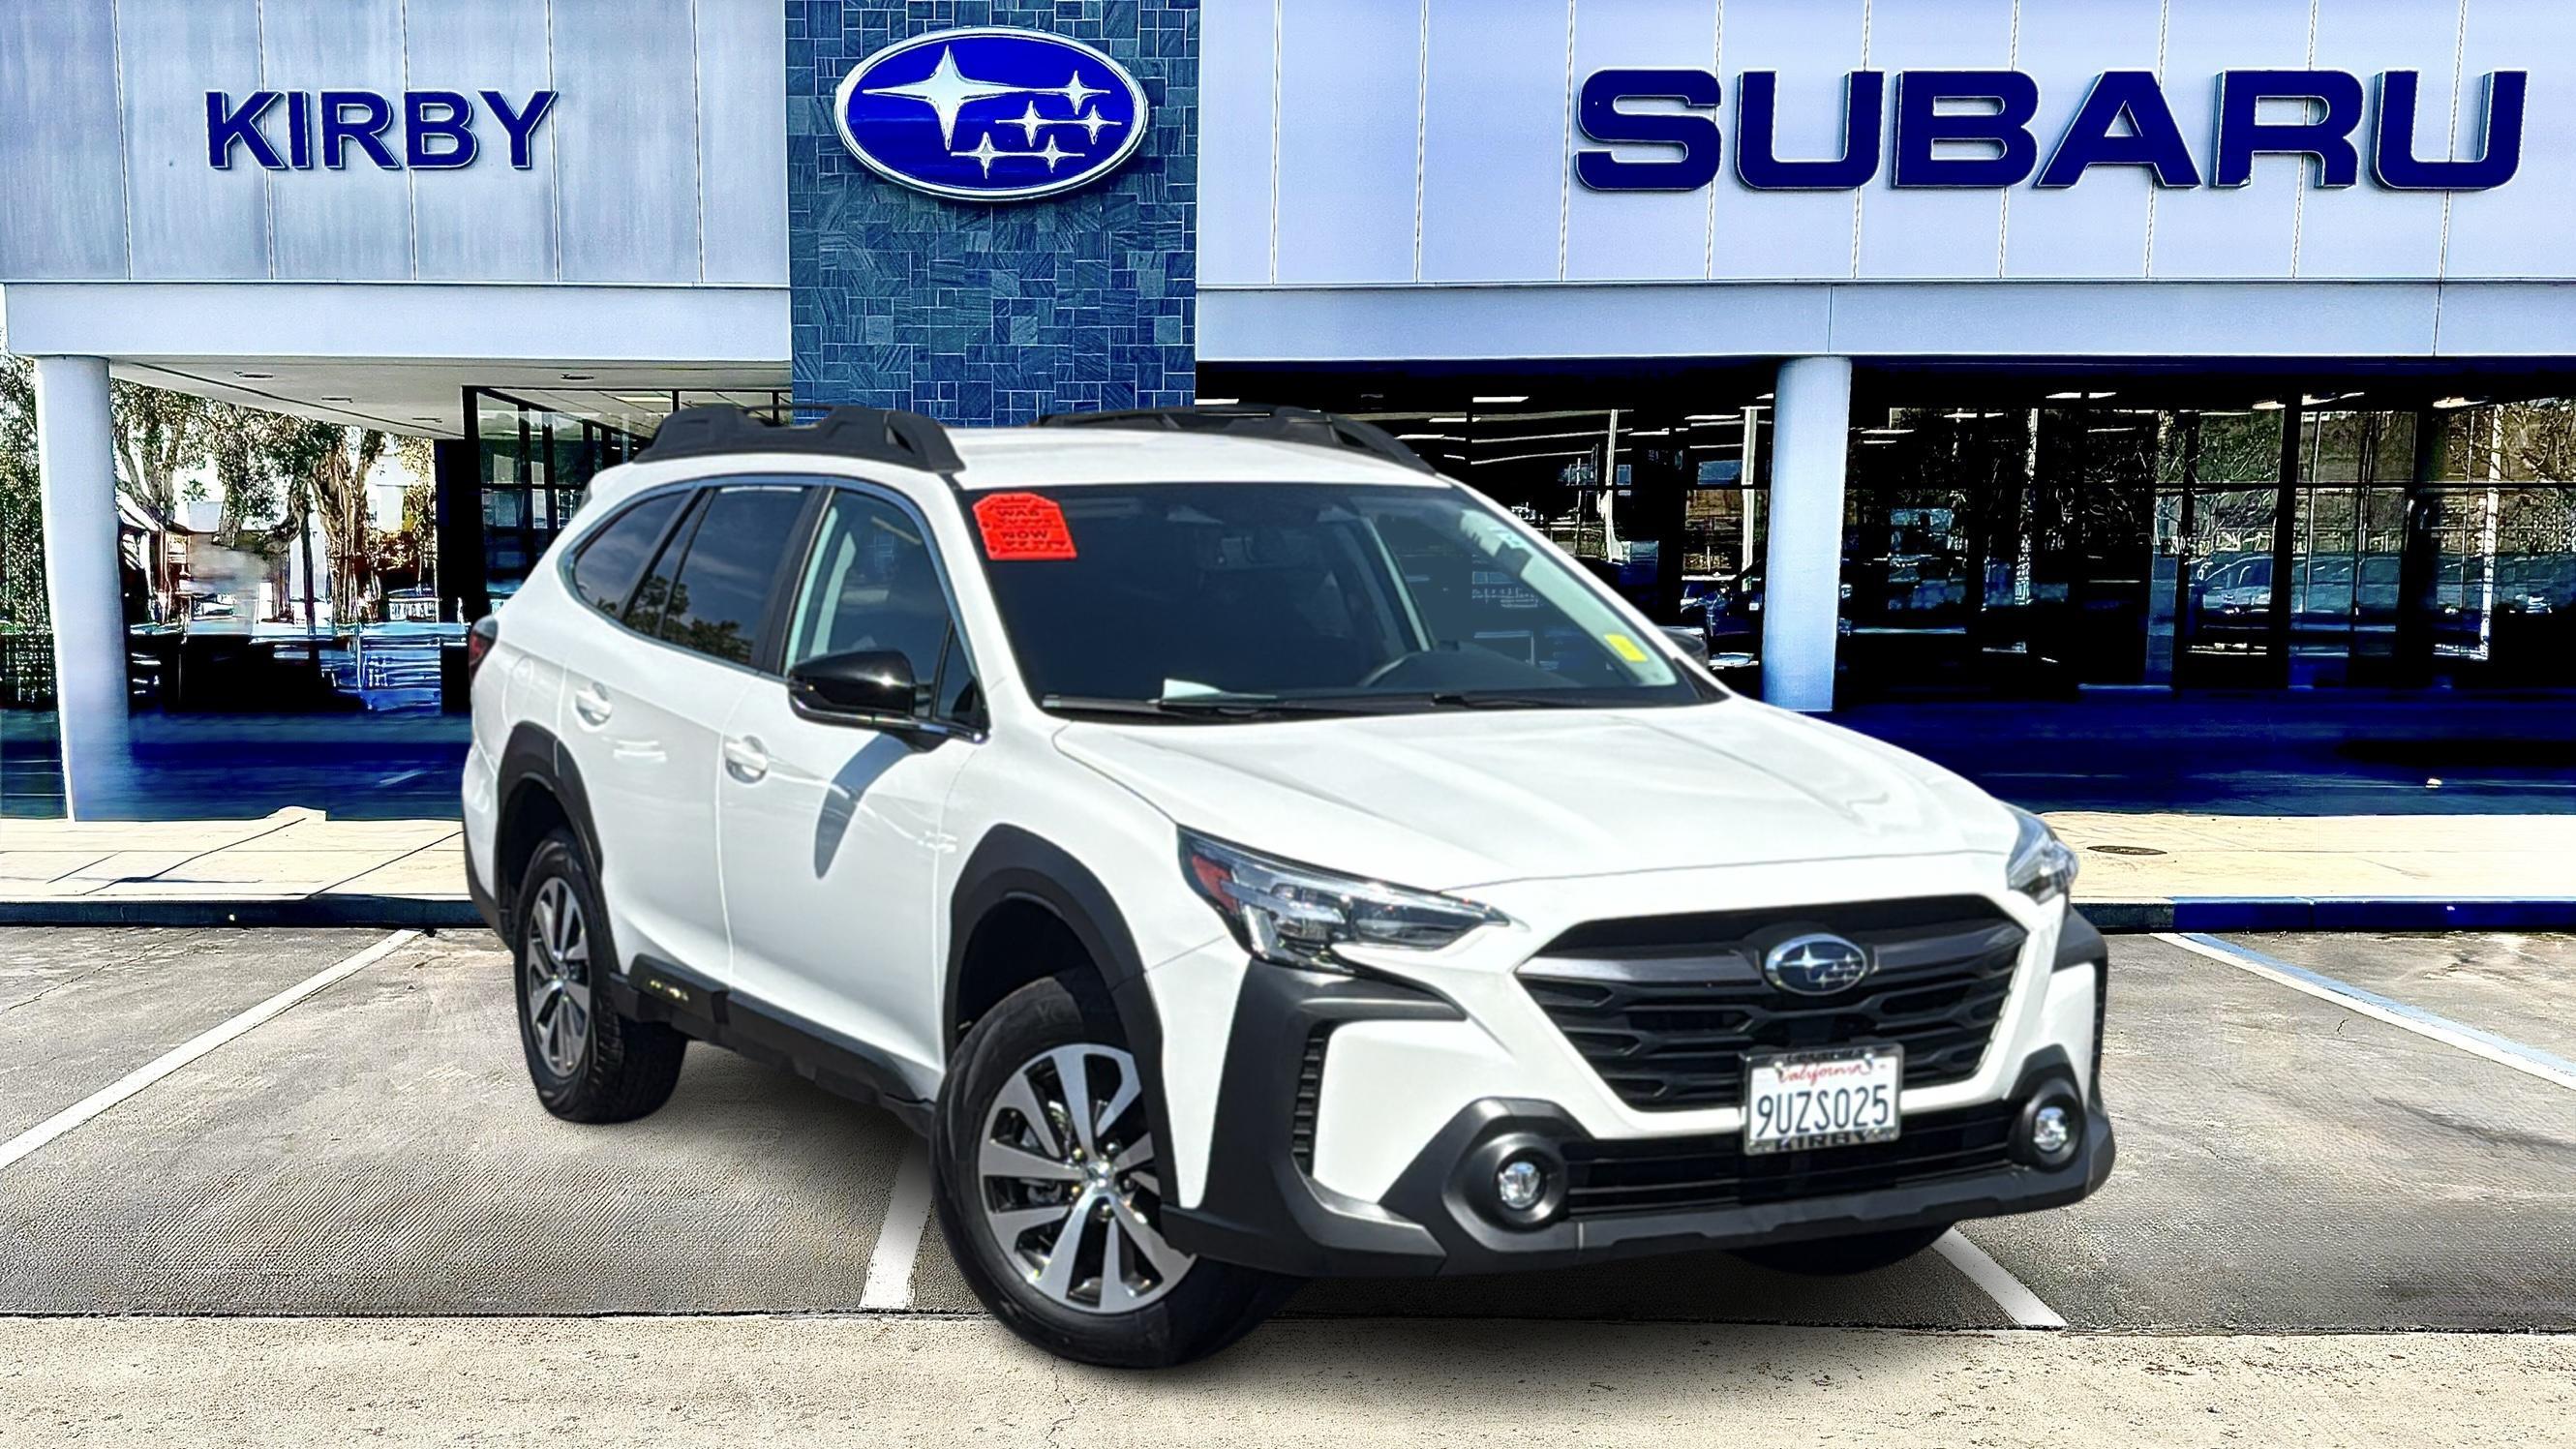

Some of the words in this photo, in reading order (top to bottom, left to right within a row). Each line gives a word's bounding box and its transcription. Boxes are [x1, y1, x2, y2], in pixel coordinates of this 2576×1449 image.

[205, 90, 559, 170] KIRBY
[1575, 69, 2528, 192] SUBARU
[1000, 530, 1048, 539] NOW
[1777, 1063, 1872, 1085] California
[1757, 1084, 1890, 1137] 9UZS025
[1776, 1131, 1869, 1151] KIRBY
